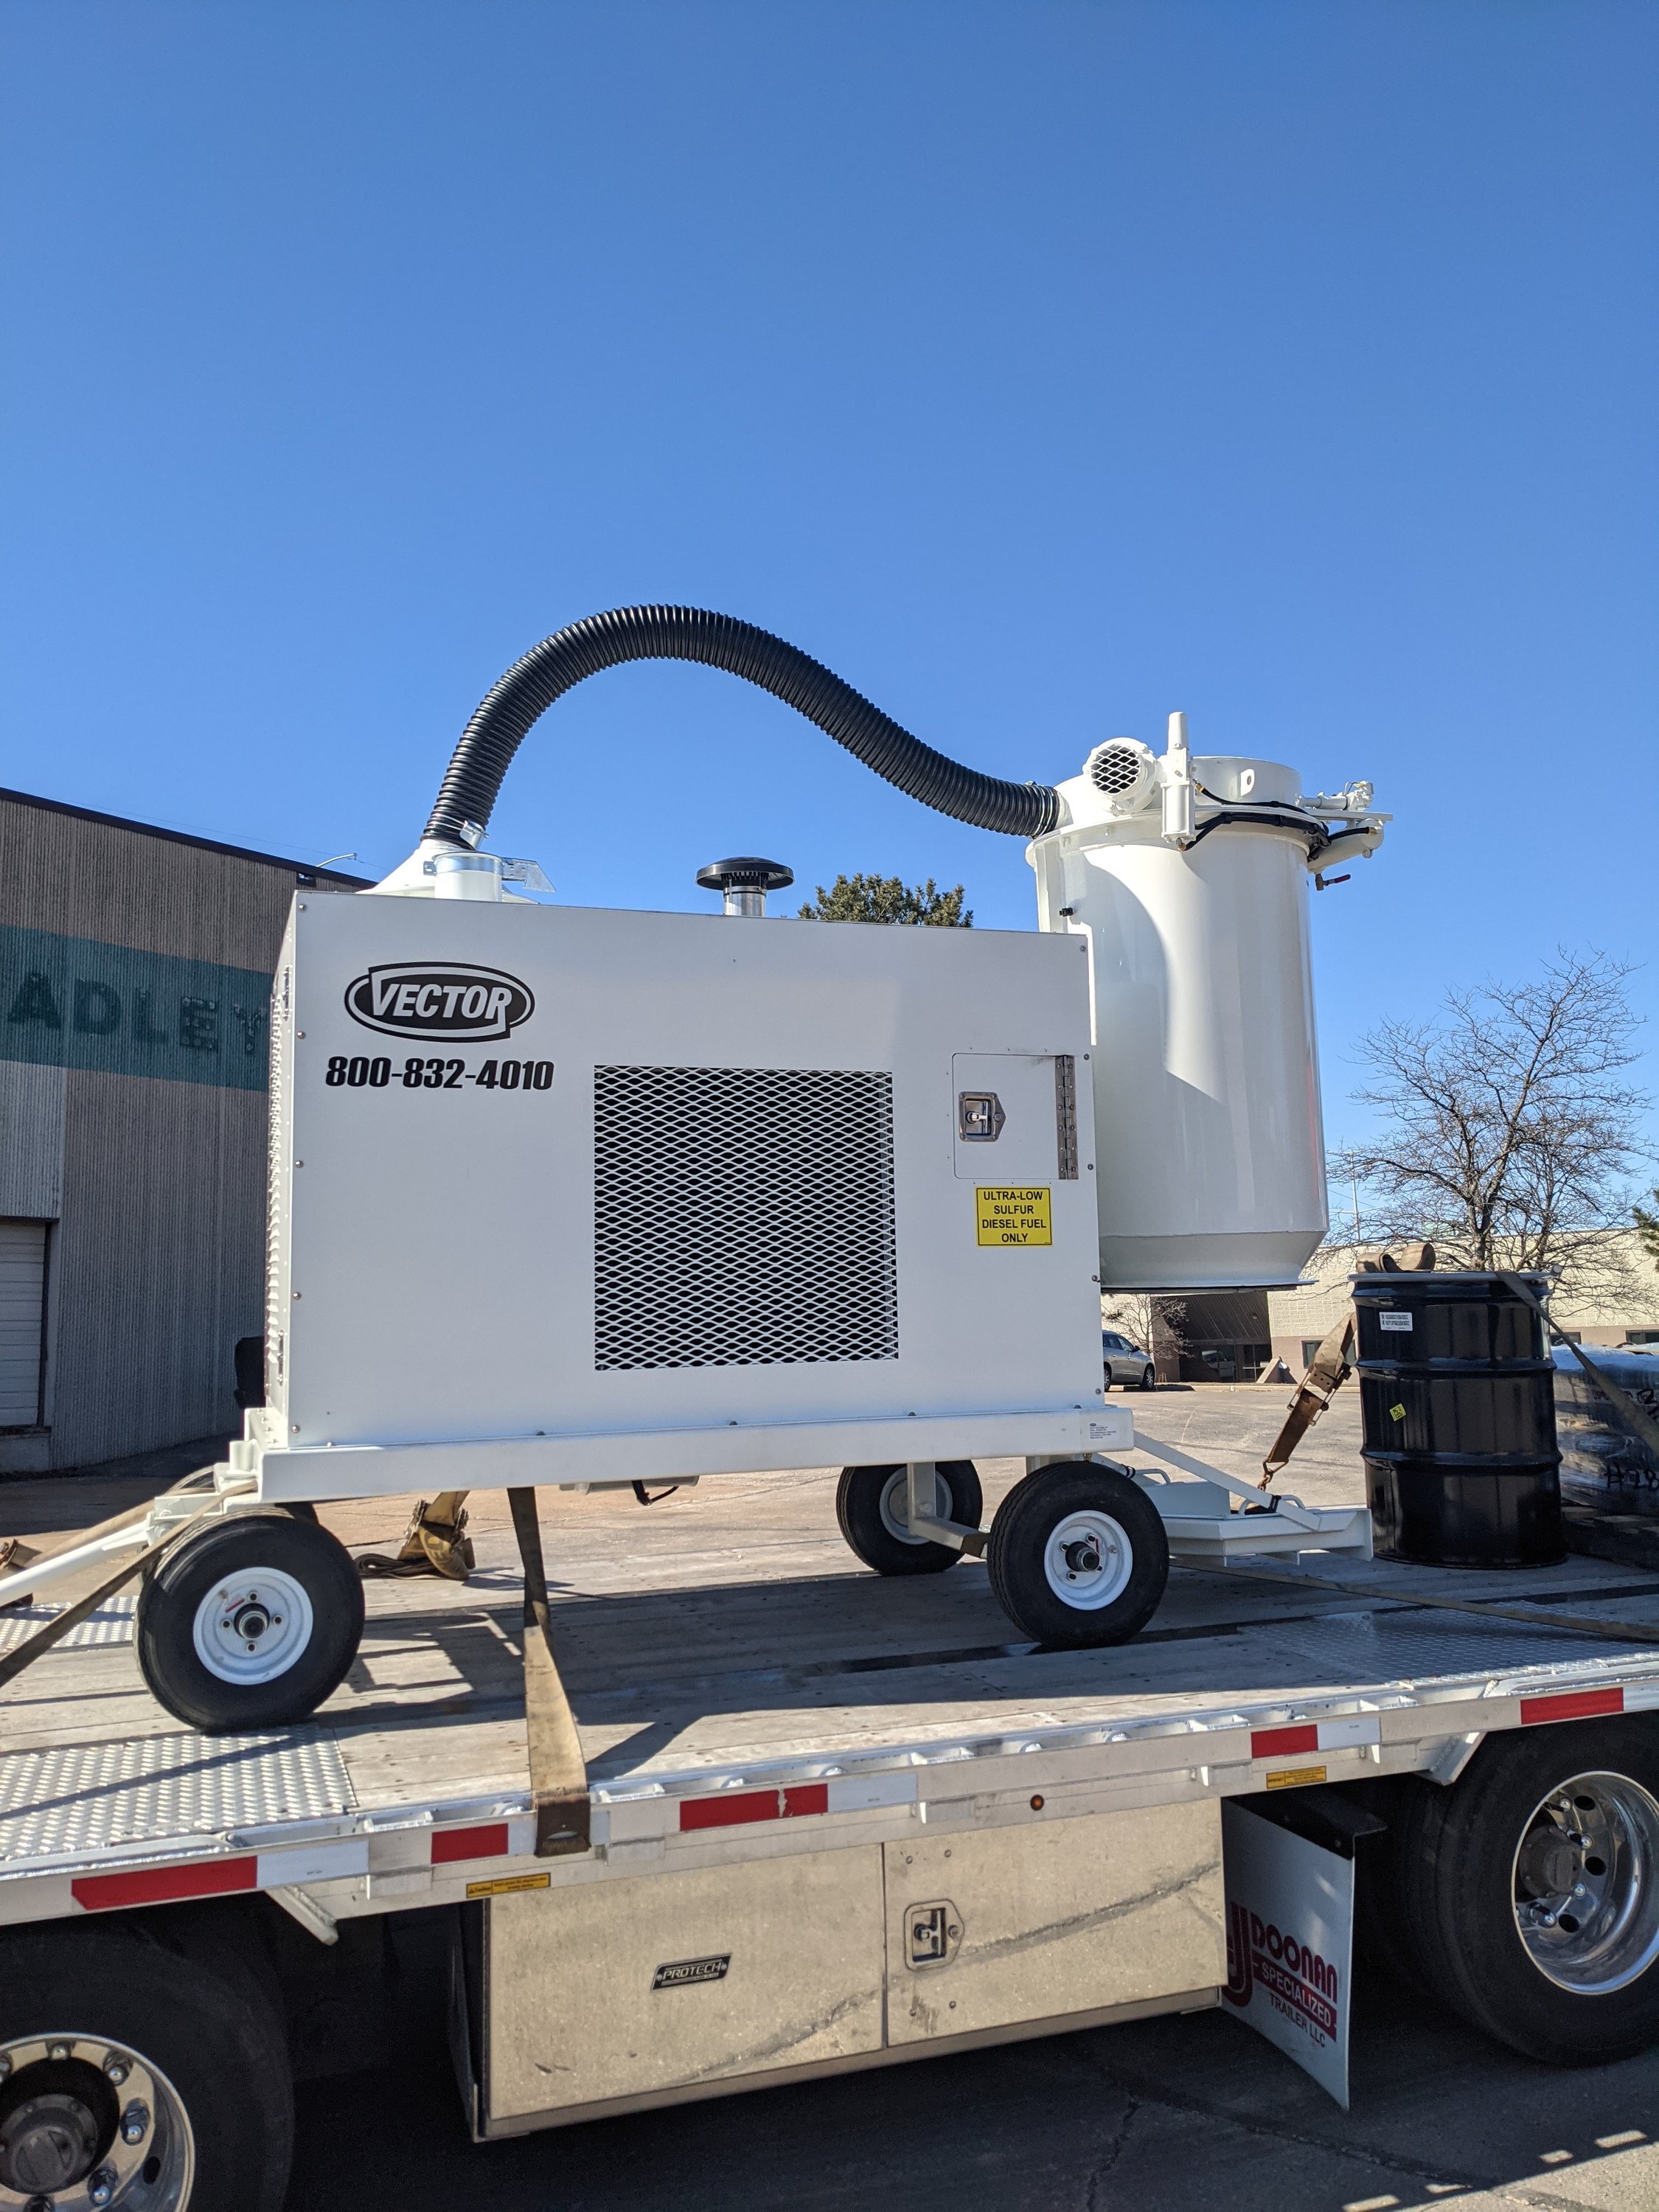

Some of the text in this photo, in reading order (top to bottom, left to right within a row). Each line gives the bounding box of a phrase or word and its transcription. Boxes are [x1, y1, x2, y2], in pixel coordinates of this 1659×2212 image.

[371, 973, 512, 1032] VECTOR
[326, 1056, 554, 1091] 800-832-4010
[984, 1191, 1043, 1200] ULTRA-LOW
[993, 1205, 1034, 1214] SULFUR
[982, 1219, 1046, 1228] DIESEL FUEL
[1001, 1233, 1028, 1243] ONLY
[663, 1961, 722, 1980] PROTECH
[1251, 1911, 1338, 2005] DOONAN
[1262, 1962, 1332, 2027] SPECIALIZED
[1270, 1992, 1326, 2048] TRAILER LLC
